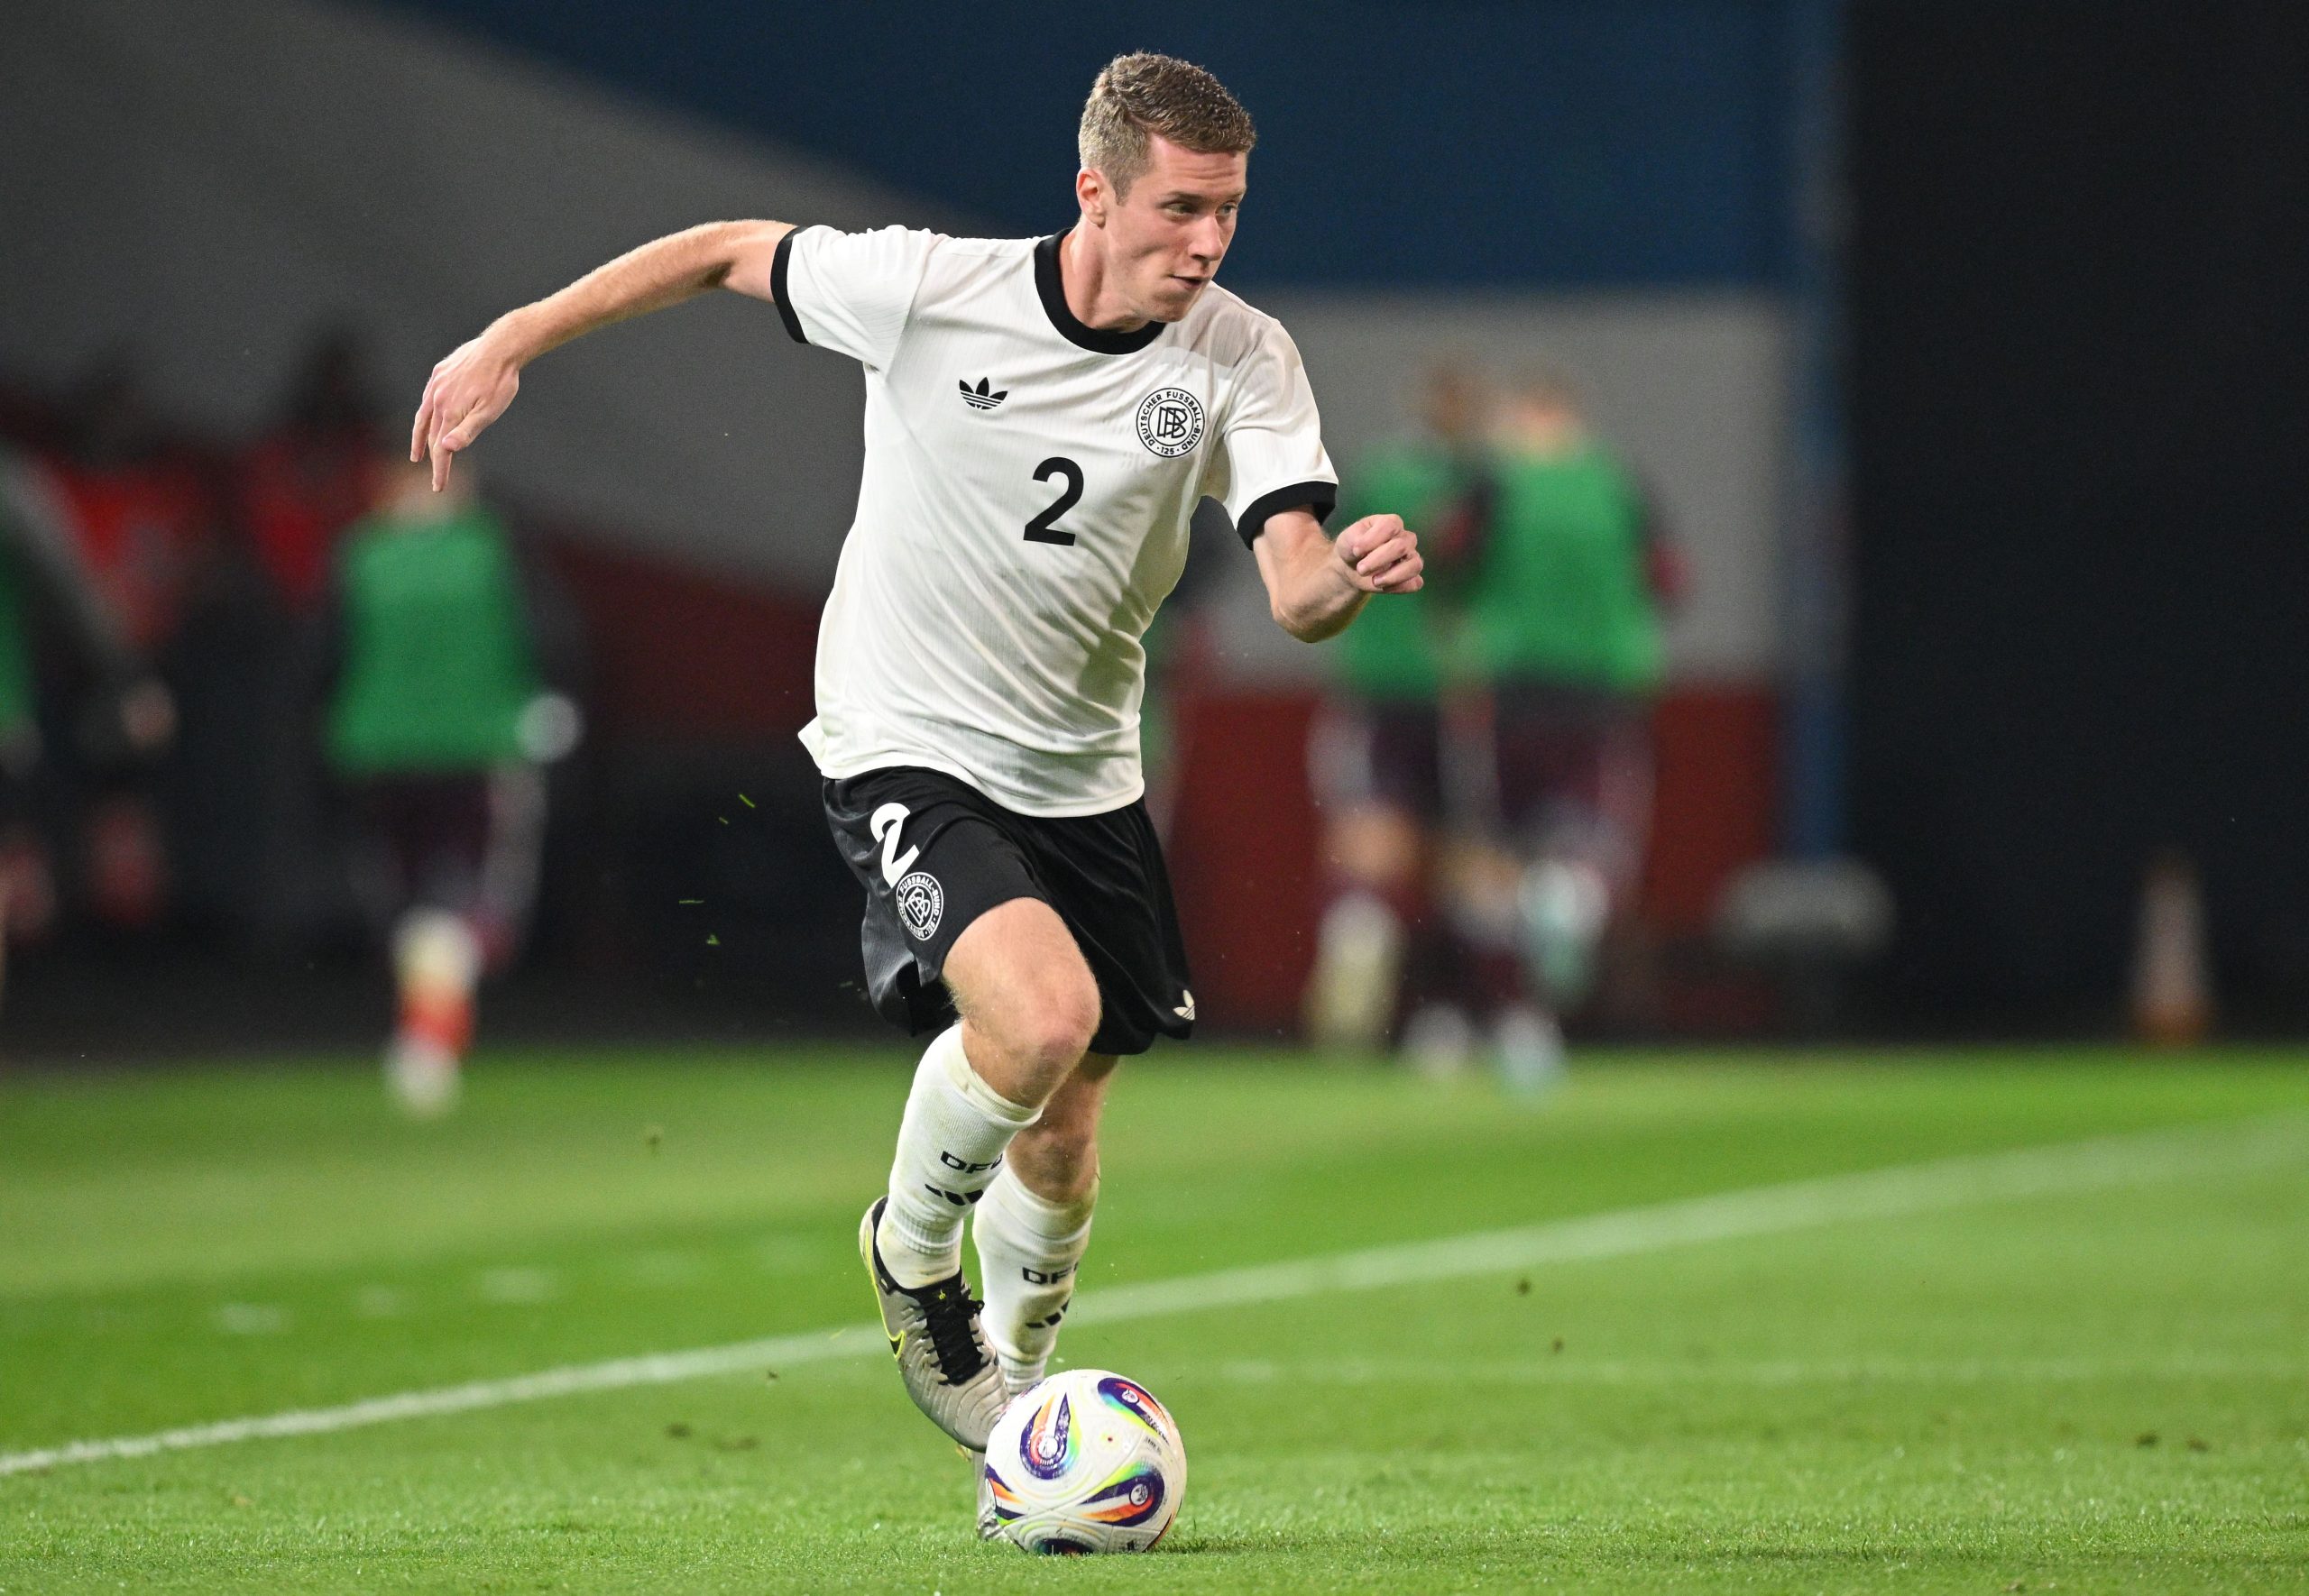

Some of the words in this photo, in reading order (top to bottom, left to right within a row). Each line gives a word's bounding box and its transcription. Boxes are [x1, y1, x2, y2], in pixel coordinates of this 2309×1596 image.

[1140, 394, 1163, 447] DEUTSCHER
[1166, 390, 1202, 451] FUSSBALL-BUND
[1160, 446, 1175, 455] 125
[1023, 456, 1084, 546] 2
[869, 802, 920, 889] 2
[1022, 1261, 1079, 1285] DF
